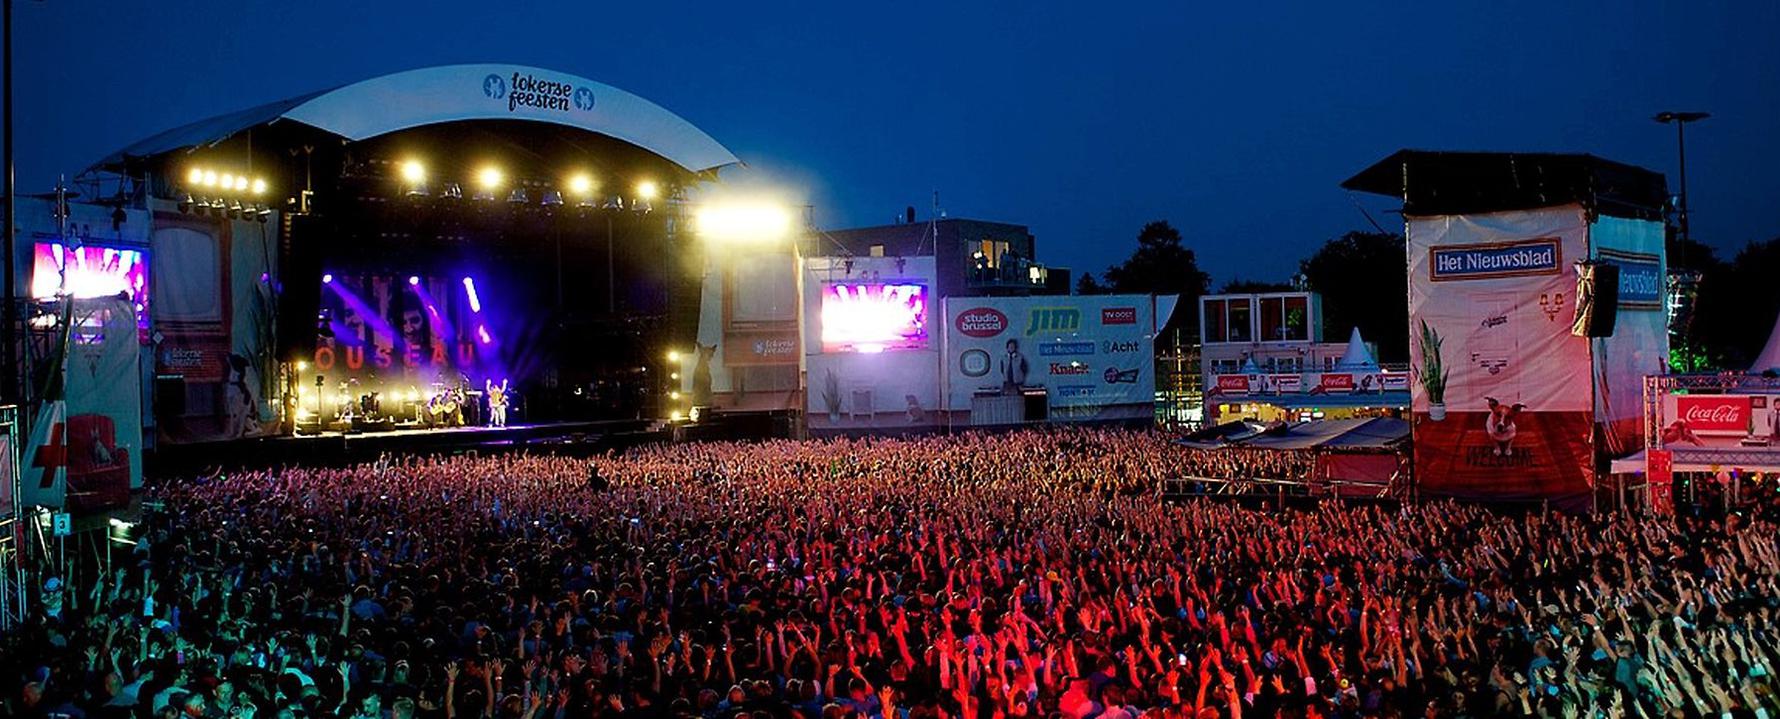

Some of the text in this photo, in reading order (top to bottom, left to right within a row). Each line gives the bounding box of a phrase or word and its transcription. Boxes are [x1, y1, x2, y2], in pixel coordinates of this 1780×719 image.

[508, 90, 570, 112] feesten
[1438, 248, 1552, 271] Het Nieuwsblad
[1619, 269, 1658, 294] ieuwsblad
[964, 313, 998, 322] studio
[962, 321, 1001, 331] brussel
[59, 520, 66, 530] 3
